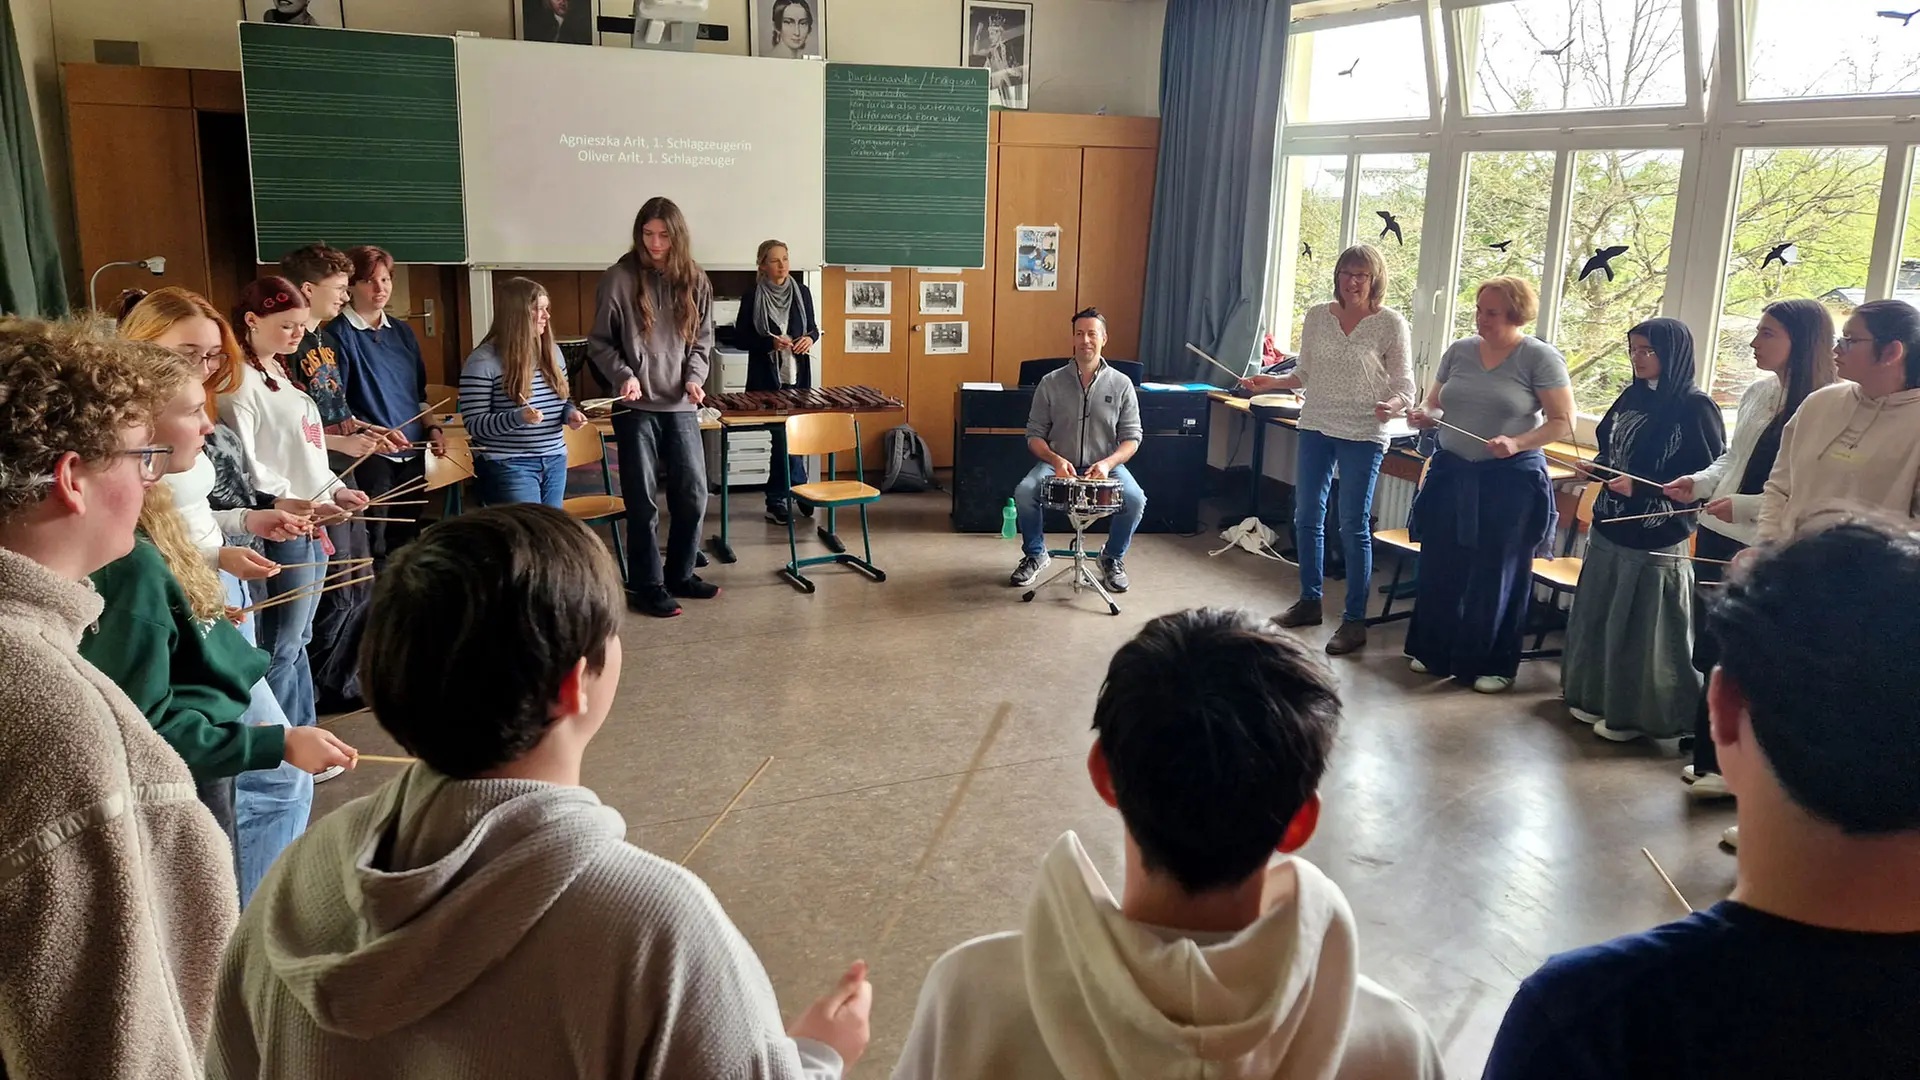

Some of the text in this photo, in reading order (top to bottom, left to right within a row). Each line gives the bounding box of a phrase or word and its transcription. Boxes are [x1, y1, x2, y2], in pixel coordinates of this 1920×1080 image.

[896, 101, 917, 111] also
[916, 112, 938, 122] Ebene
[941, 113, 961, 123] über
[559, 133, 752, 153] Agnieszka Arlt, 1. Schlagzeugerin
[578, 150, 737, 168] Oliver Arlt, 1. Schlagzeuger
